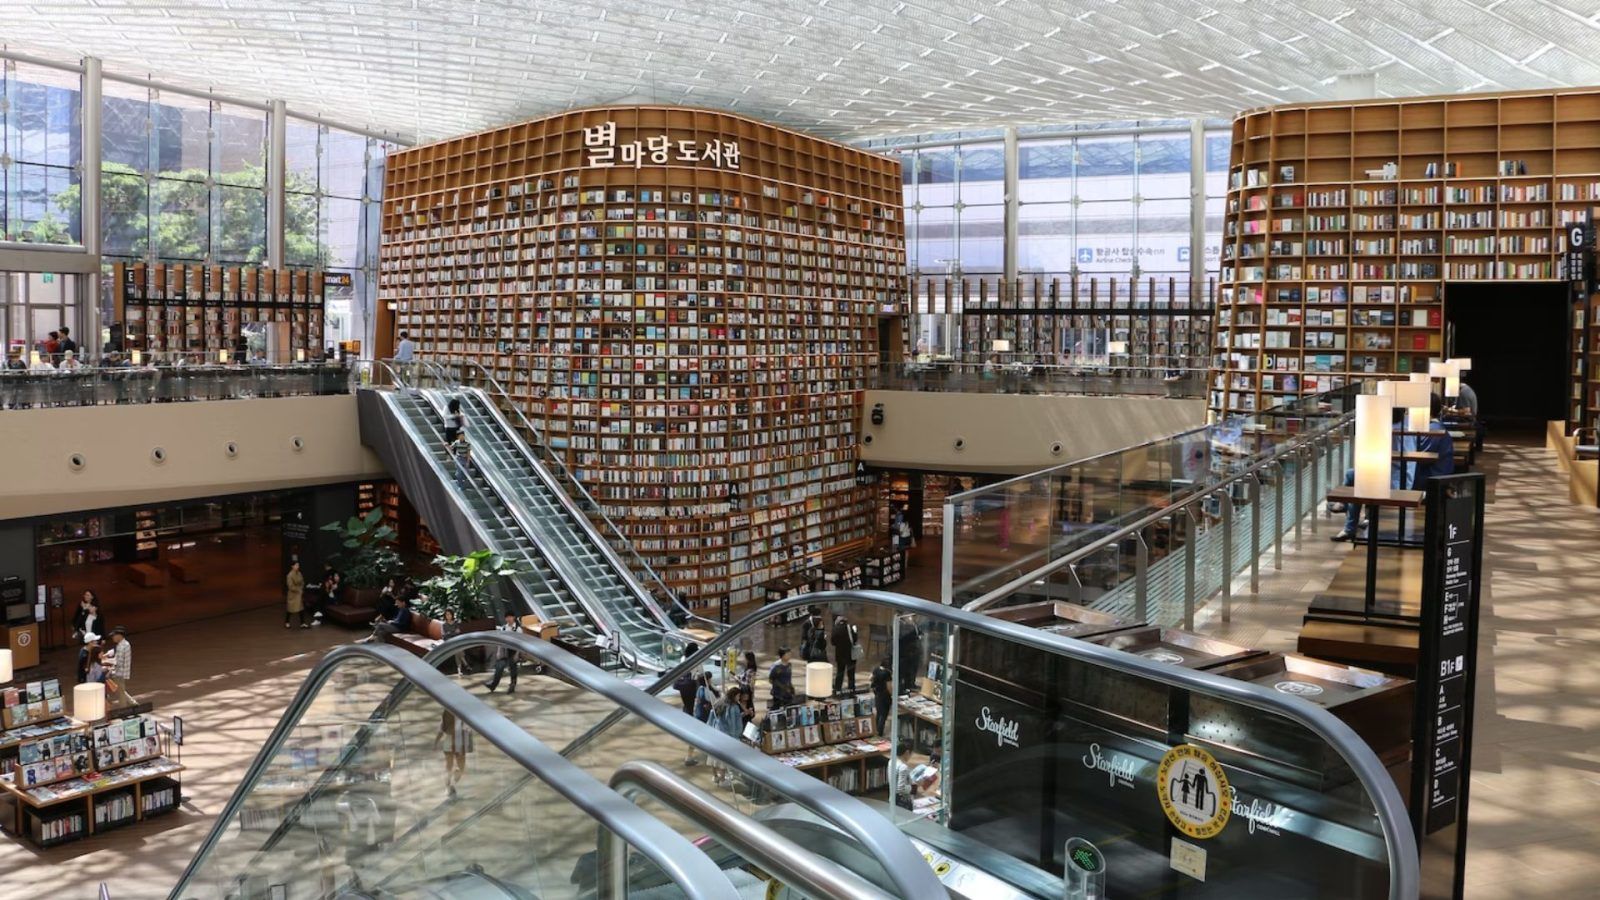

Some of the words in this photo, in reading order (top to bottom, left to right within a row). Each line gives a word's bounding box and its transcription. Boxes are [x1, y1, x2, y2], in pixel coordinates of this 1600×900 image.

[583, 120, 673, 169] 별마당
[675, 138, 741, 169] 도서관
[1571, 227, 1583, 246] G
[324, 275, 350, 285] mart24
[857, 462, 864, 471] A
[731, 484, 738, 495] A
[1448, 523, 1457, 540] 1F
[1440, 659, 1455, 677] B1F
[975, 706, 1019, 747] Starfield
[1083, 743, 1135, 787] Starfield
[1229, 785, 1281, 834] tarfield
